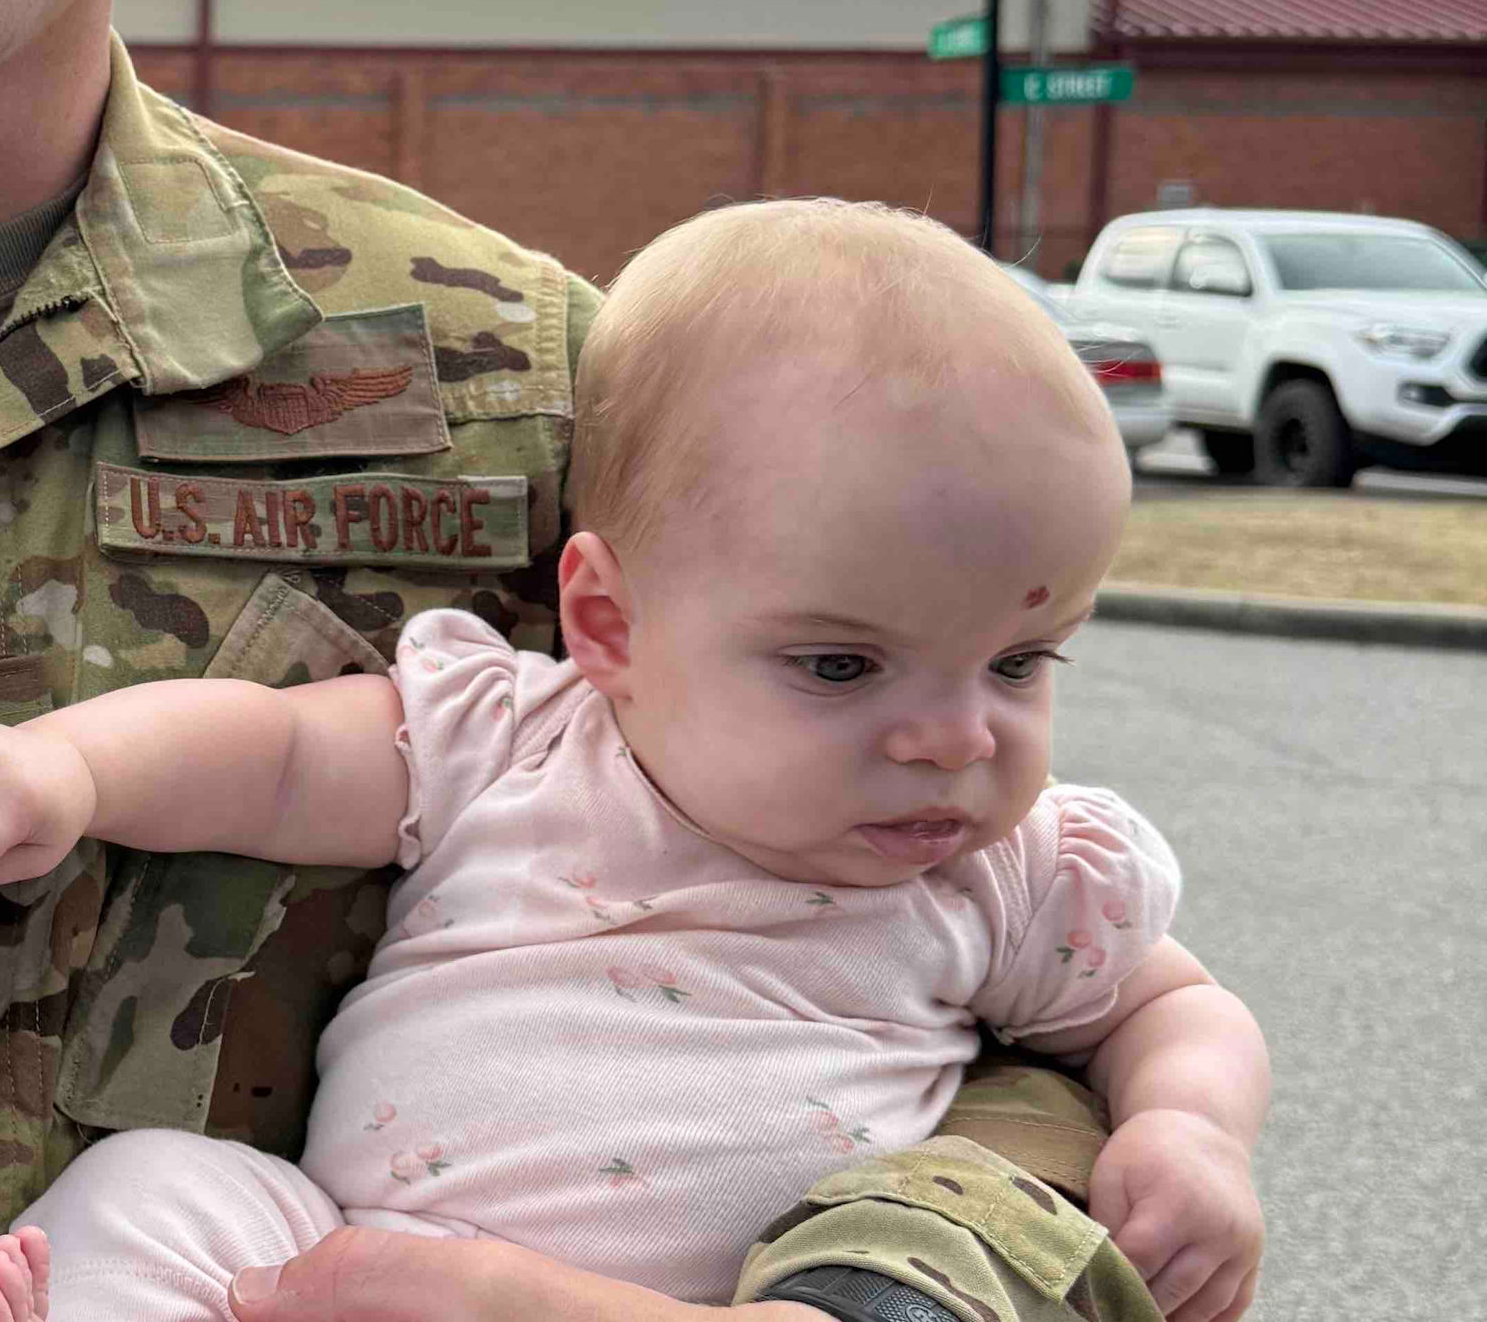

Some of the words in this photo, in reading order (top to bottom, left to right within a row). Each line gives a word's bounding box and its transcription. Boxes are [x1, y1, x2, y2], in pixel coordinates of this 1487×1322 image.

[130, 477, 220, 544] U.S.
[233, 489, 317, 549] AIR
[335, 483, 492, 557] FORCE
